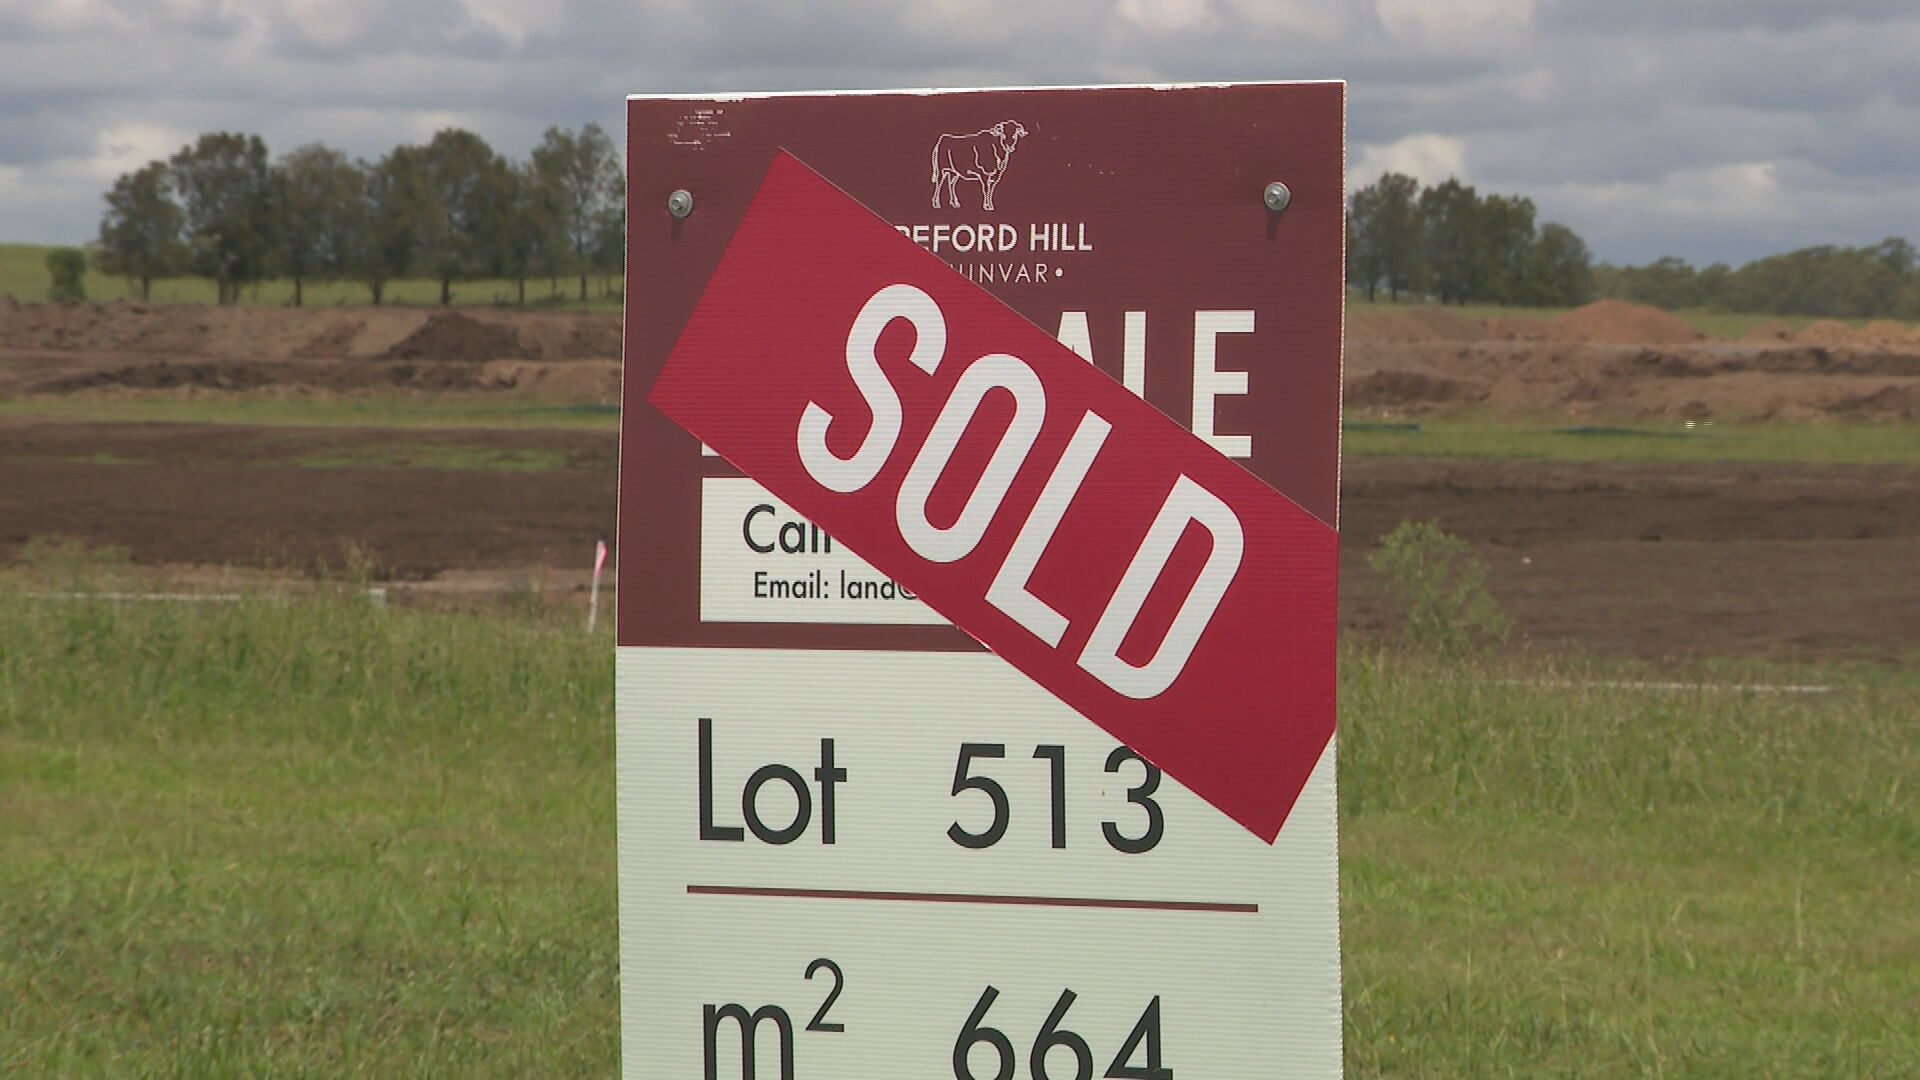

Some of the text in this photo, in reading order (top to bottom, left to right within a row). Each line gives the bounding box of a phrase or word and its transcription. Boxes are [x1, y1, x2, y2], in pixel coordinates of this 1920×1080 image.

[1029, 223, 1093, 251] HILL
[797, 283, 1245, 700] SOLD
[754, 570, 829, 599] Email:
[698, 718, 1164, 854] Lot 513
[953, 985, 1173, 1080] 664
